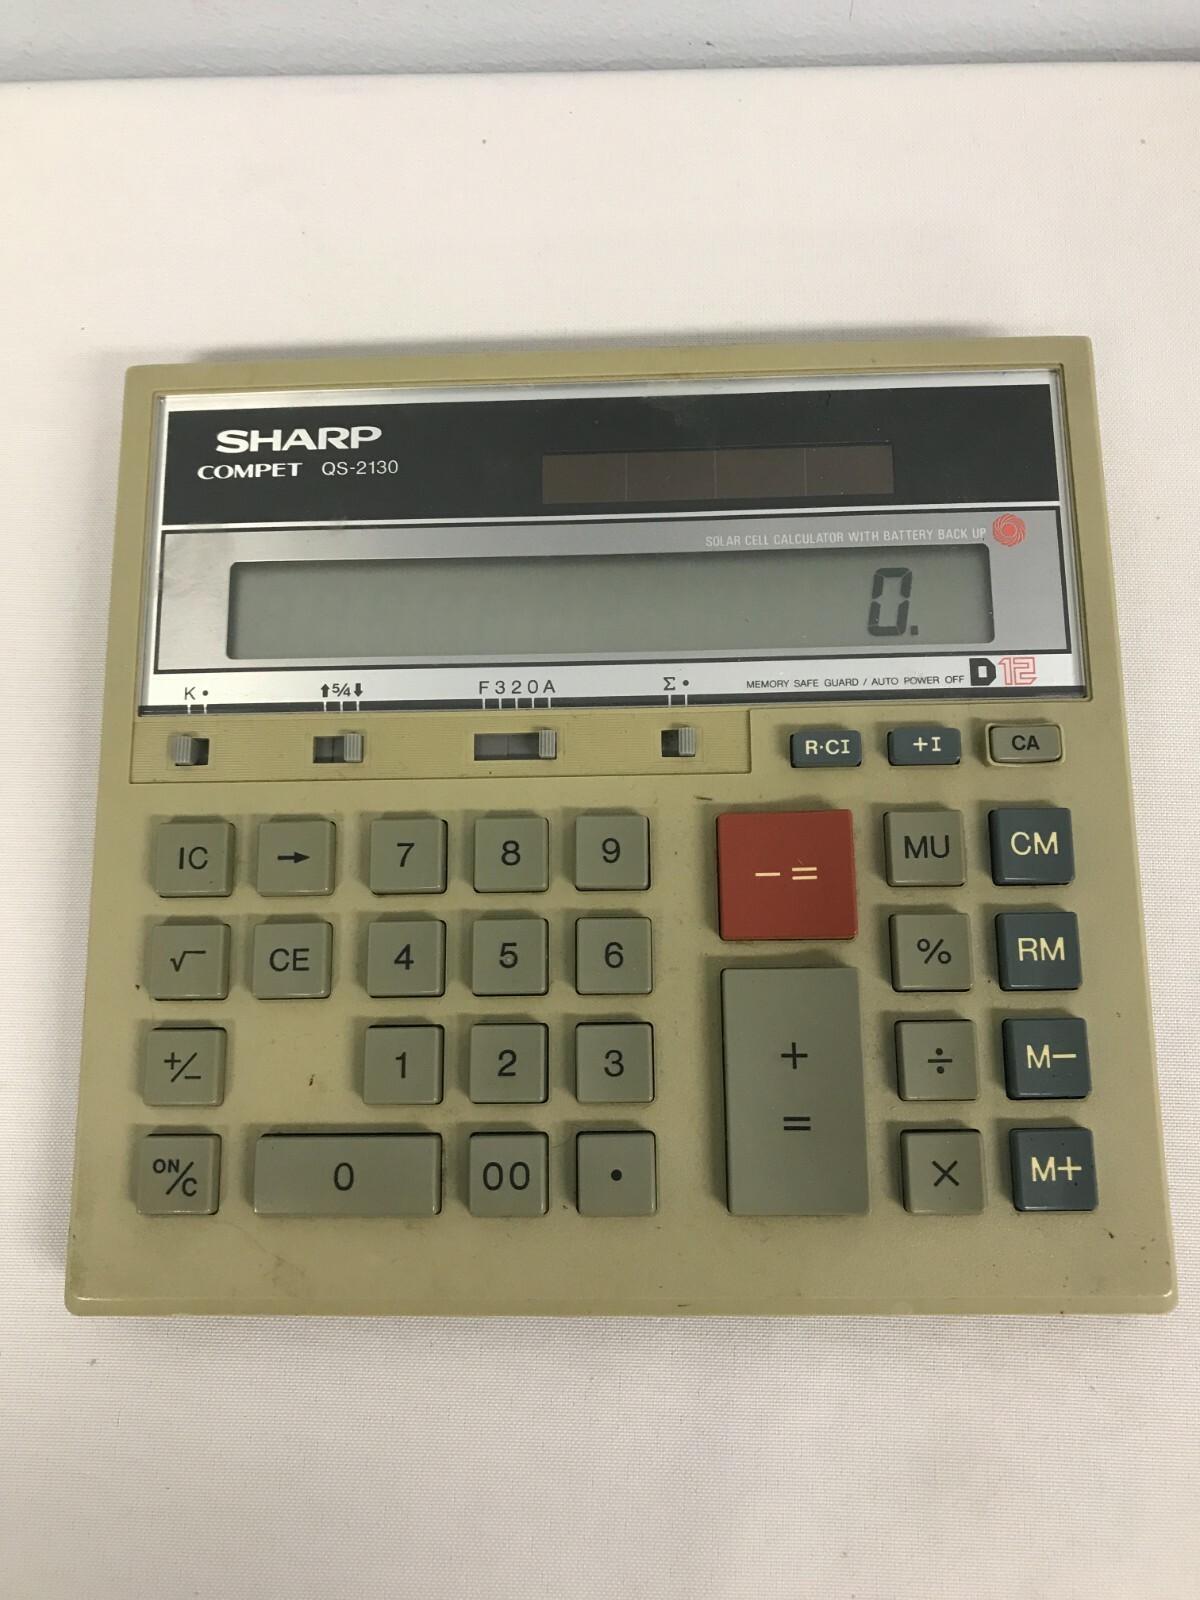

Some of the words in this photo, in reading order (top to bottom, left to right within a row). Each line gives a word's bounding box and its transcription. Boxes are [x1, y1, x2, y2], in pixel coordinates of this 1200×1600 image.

[215, 425, 382, 454] SHARP
[197, 462, 303, 480] COMPET
[321, 459, 399, 477] QS-2130
[705, 535, 741, 547] SOLAR
[744, 534, 769, 546] CELL
[773, 532, 844, 545] CALCULATOR
[848, 530, 880, 542] WITH
[883, 529, 933, 541] BATTERY
[938, 528, 968, 540] BACK
[972, 527, 987, 539] UP
[746, 679, 790, 689] MEMORY
[793, 678, 819, 688] SAFE
[824, 677, 859, 687] GUARD
[871, 676, 899, 686] AUTO
[904, 675, 940, 685] POWER
[945, 675, 965, 684] OFF
[1011, 735, 1040, 751] CA
[396, 842, 415, 867] 7
[501, 840, 521, 866] 8
[601, 837, 621, 864] 9
[904, 835, 950, 859] MU
[1010, 831, 1059, 856] CM
[179, 847, 208, 870] IC
[269, 949, 310, 972] CE
[394, 944, 414, 970] 4
[499, 942, 518, 968] 5
[604, 942, 624, 968] 6
[1018, 936, 1066, 961] RM
[395, 1052, 407, 1079] 1
[497, 1049, 517, 1077] 2
[604, 1049, 624, 1077] 3
[333, 1162, 354, 1191] 0
[482, 1161, 531, 1190] 00
[1030, 1156, 1082, 1182] M+
